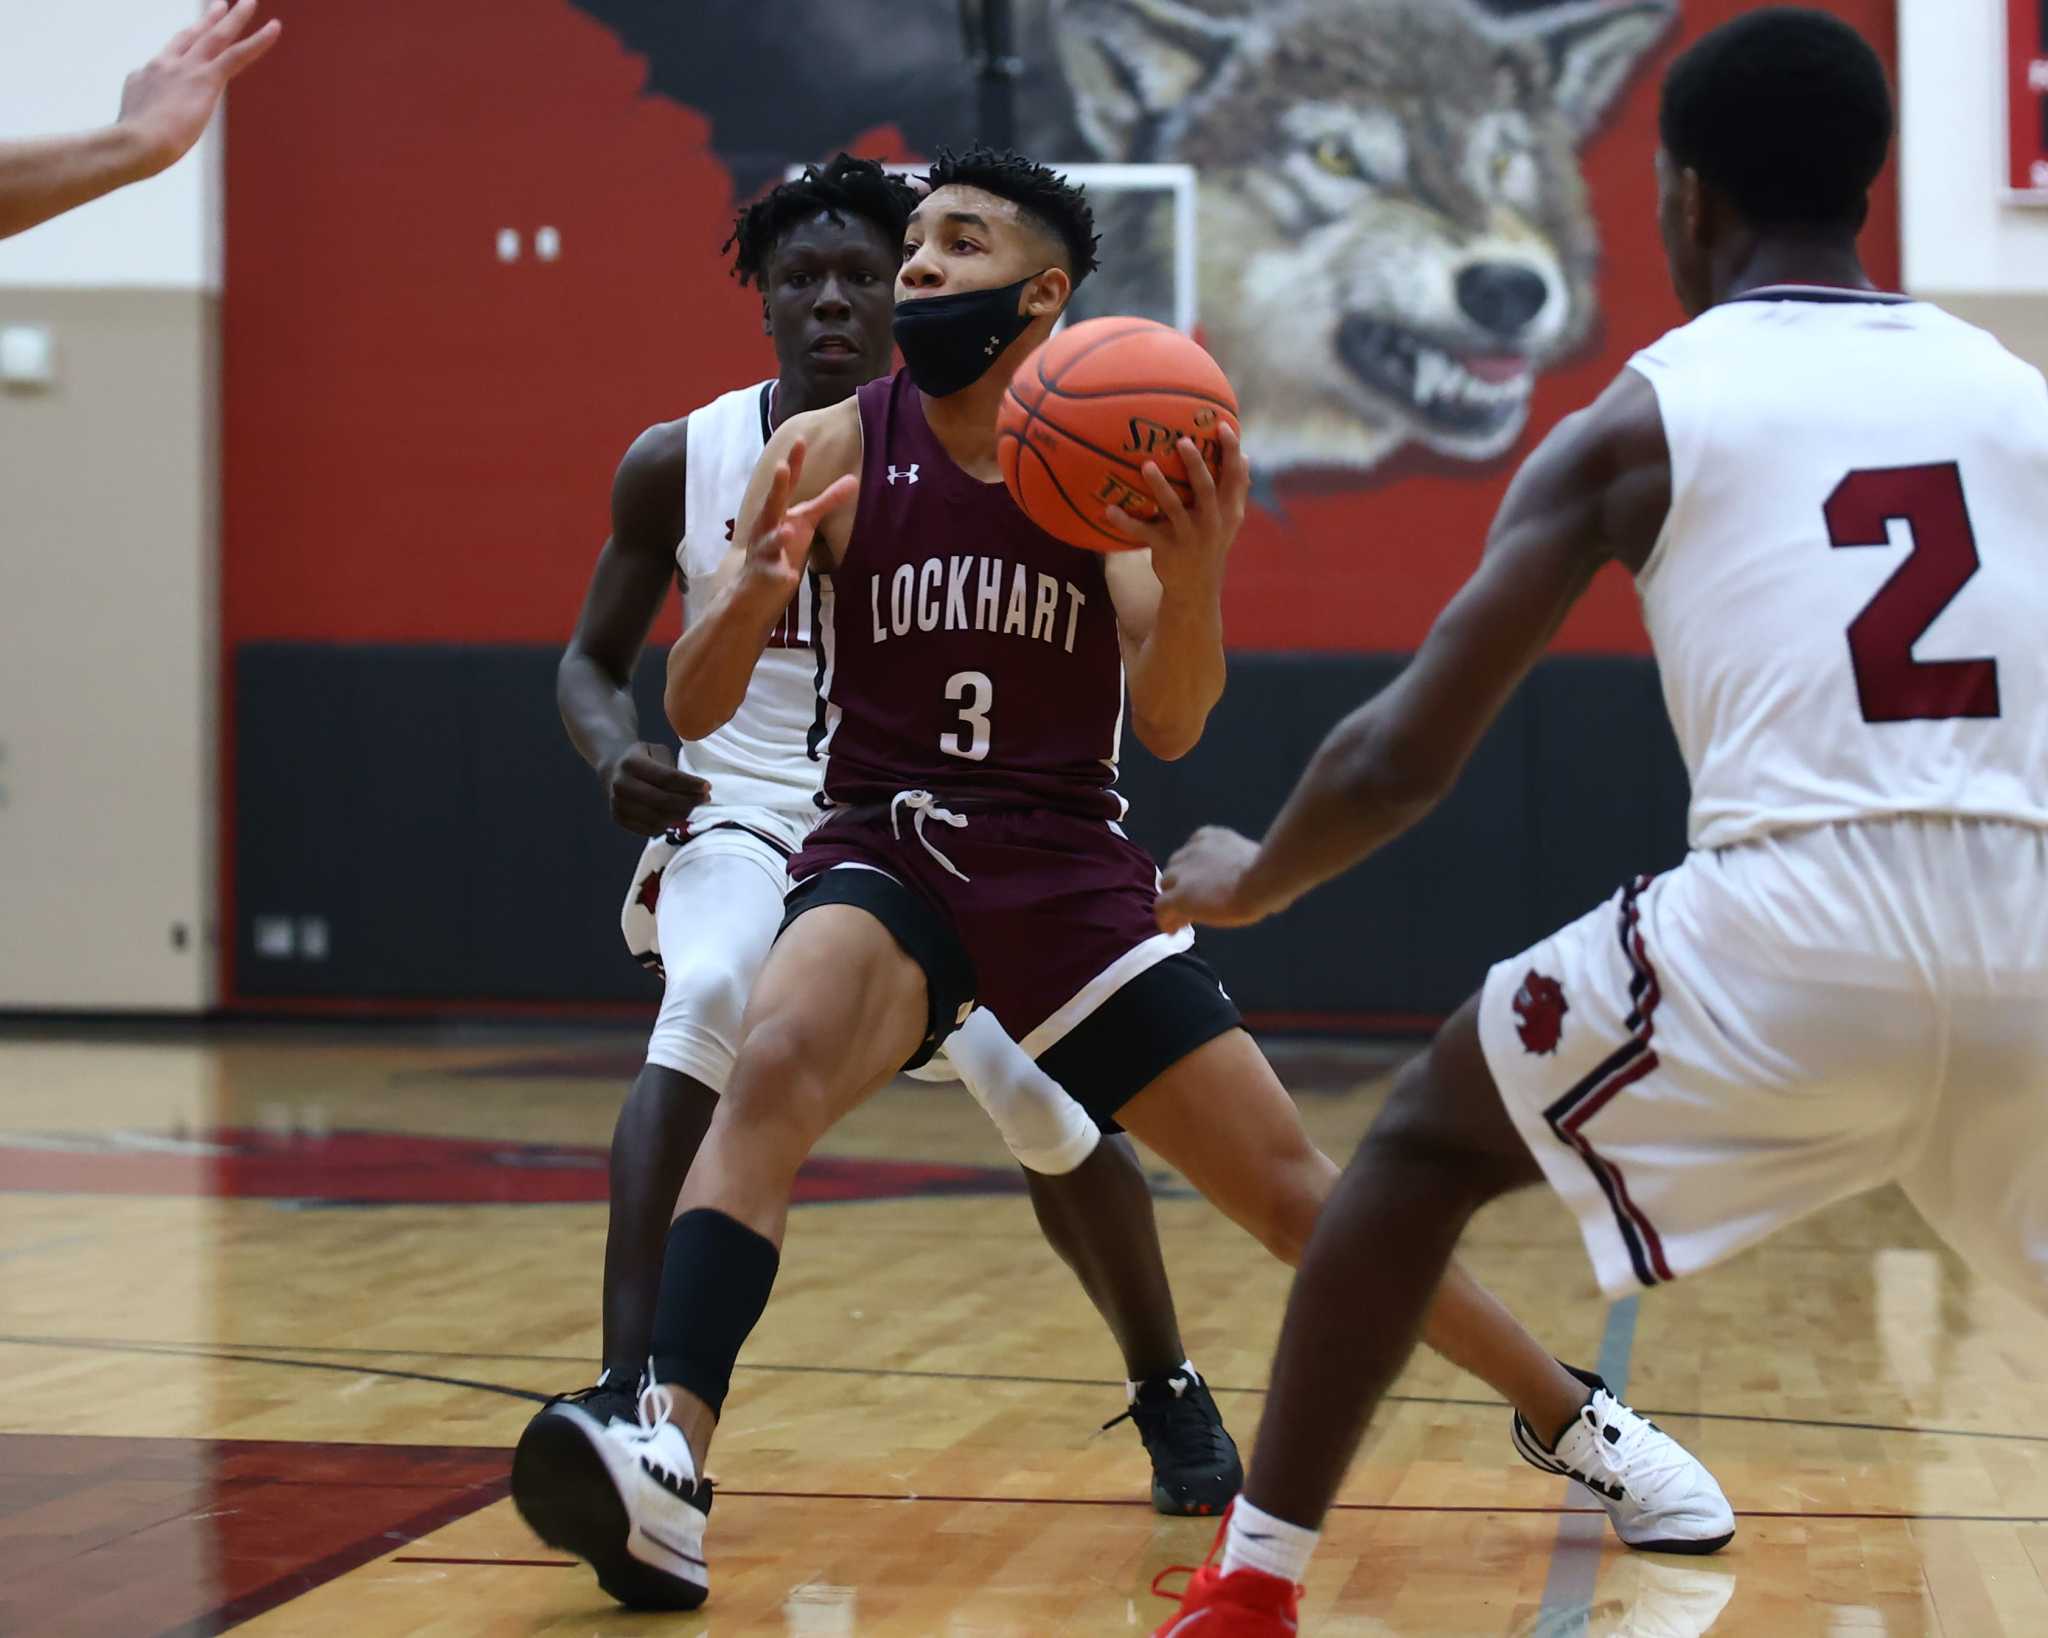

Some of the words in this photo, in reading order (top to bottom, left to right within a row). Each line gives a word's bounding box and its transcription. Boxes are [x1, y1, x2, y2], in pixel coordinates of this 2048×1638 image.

[871, 555, 1086, 653] LOCKHART
[1821, 460, 2001, 722] 2
[939, 670, 993, 761] 3
